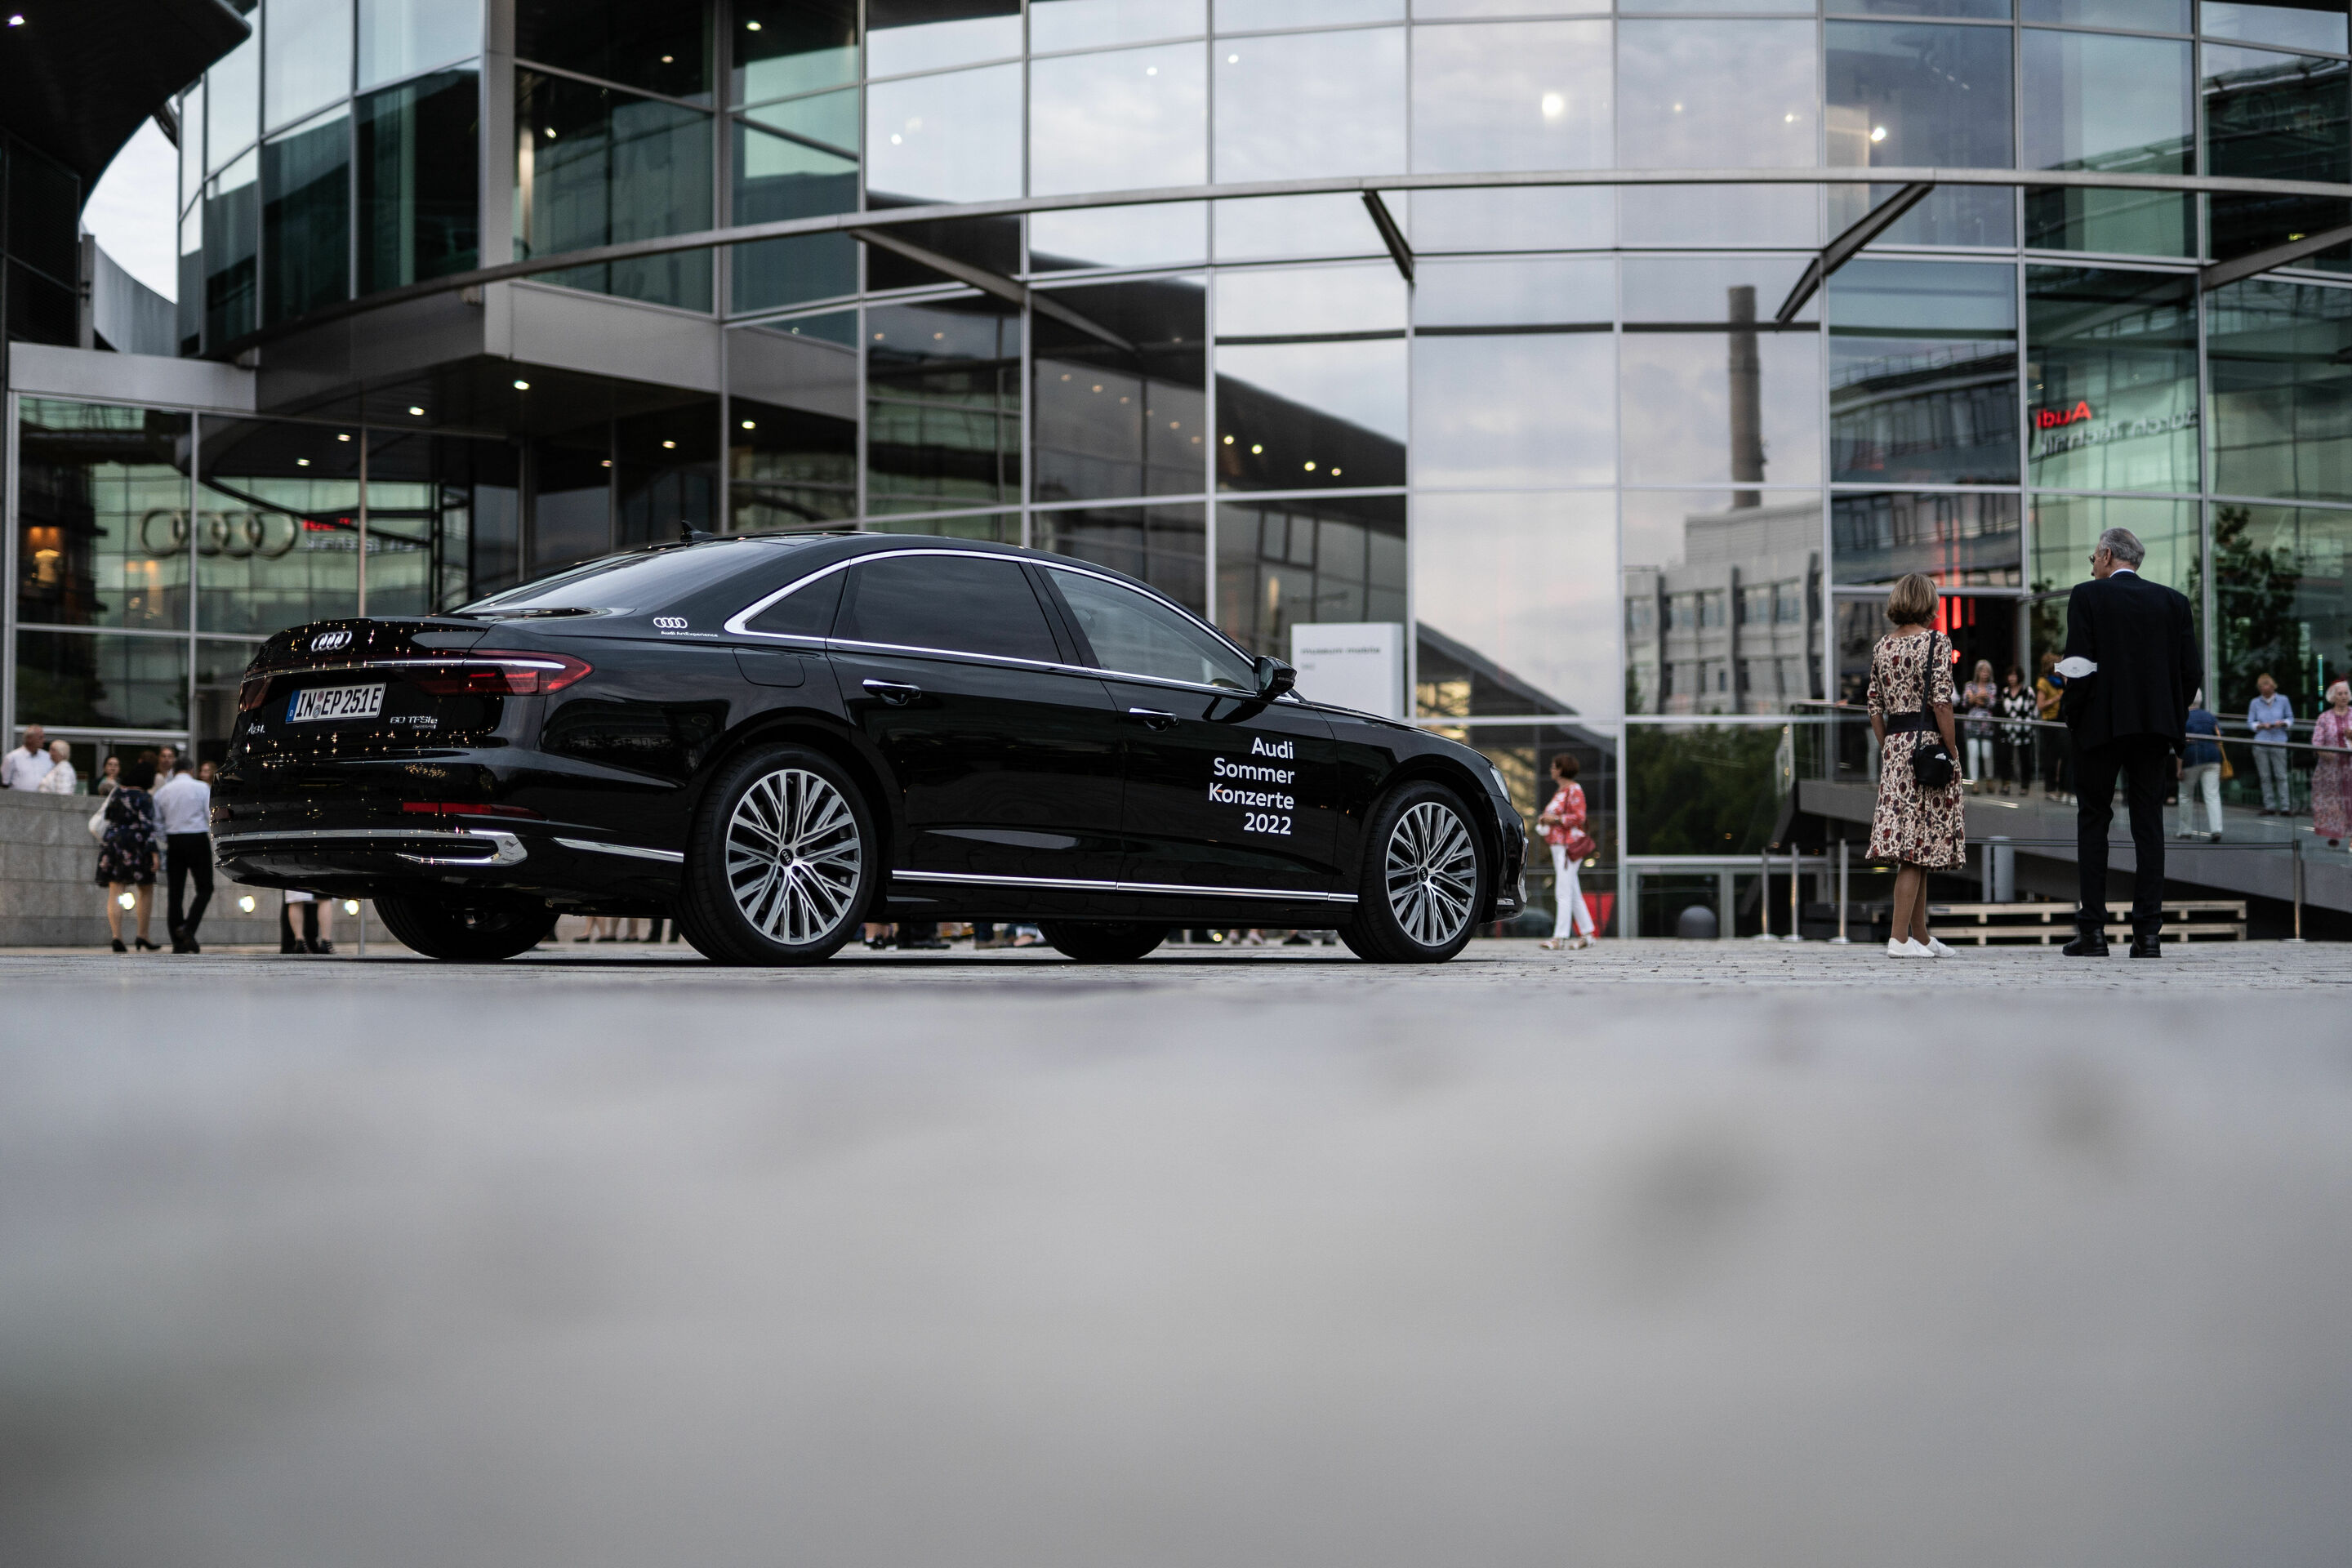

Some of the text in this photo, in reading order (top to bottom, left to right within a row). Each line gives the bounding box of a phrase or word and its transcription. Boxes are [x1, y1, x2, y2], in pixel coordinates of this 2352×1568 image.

[296, 692, 317, 717] IN
[321, 690, 342, 715] EP
[1251, 737, 1294, 759] Audi
[1214, 757, 1295, 784] Sommer
[1209, 782, 1294, 809] Konzerte
[1243, 812, 1291, 835] 2022
